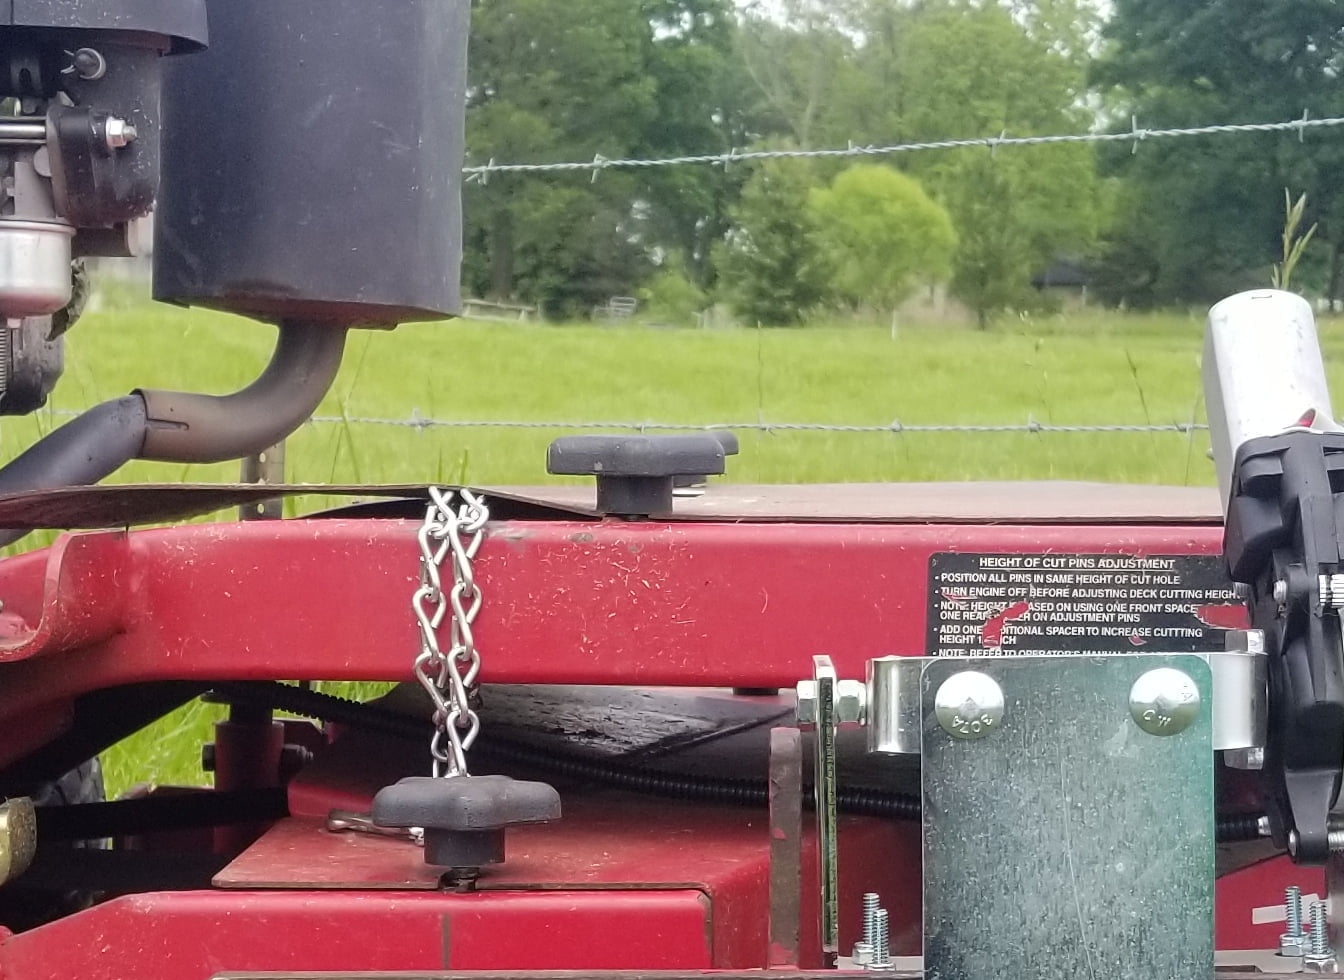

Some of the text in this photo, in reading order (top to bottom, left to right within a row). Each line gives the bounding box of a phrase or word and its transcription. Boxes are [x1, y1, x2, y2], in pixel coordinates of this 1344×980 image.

[979, 557, 1176, 569] HEIGHT OF CUT PINS ADJUSTMENT
[940, 573, 1181, 585] POSITION ALL PINS IN SAME HEIGHT OF CUT HOLE
[941, 587, 1240, 599] TURN ENGINE OFF BEFORE ADJUSTING DECK CUTTING HEIGH
[970, 601, 1008, 611] HEIGHT
[1027, 602, 1055, 612] ASED
[1055, 603, 1072, 612] ON
[1072, 603, 1104, 613] USING
[1105, 604, 1128, 613] ONE
[1129, 604, 1164, 613] FRONT
[1164, 604, 1198, 614] SPACE
[940, 611, 961, 620] ONE
[1032, 612, 1048, 621] ON
[1049, 613, 1117, 622] ADJUSTMENT
[1117, 613, 1141, 623] PINS
[939, 625, 1203, 638] ADD ONE DITIONAL SPACER TO INCREASE CUTTTING
[939, 635, 977, 644] HEIGHT
